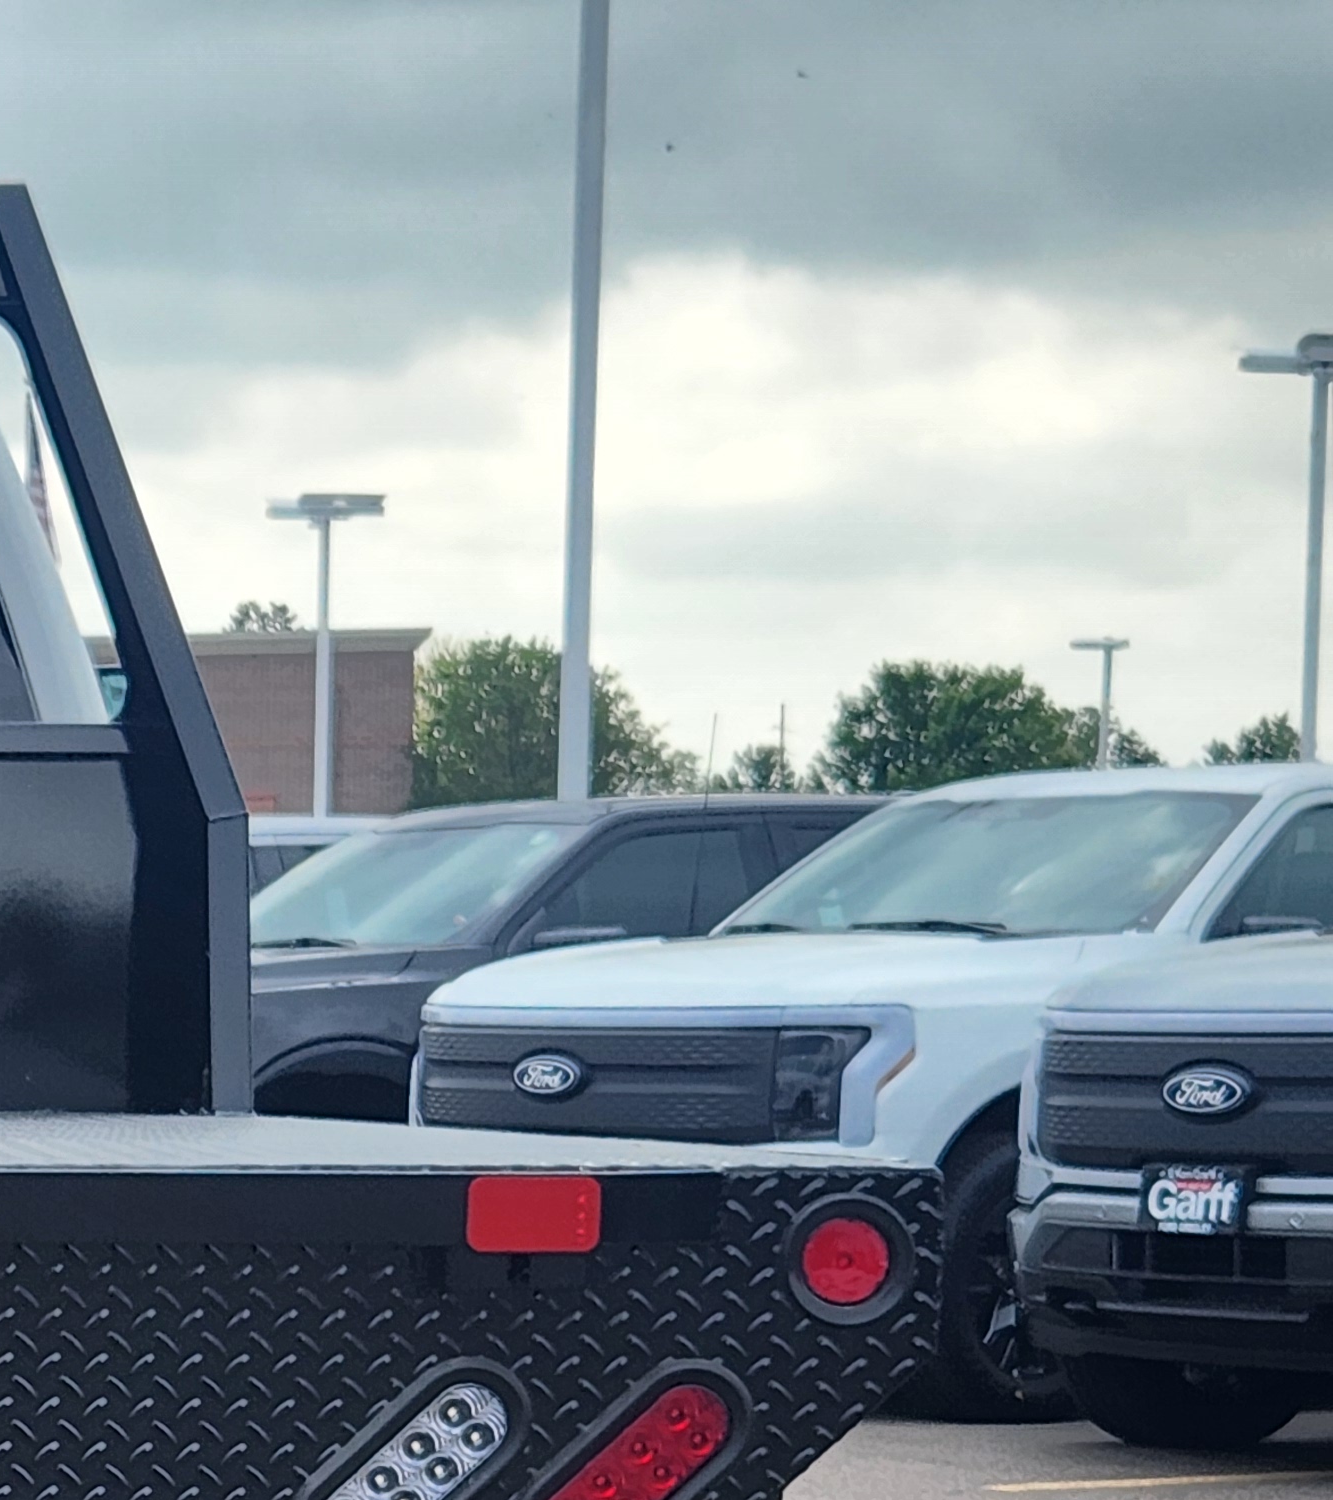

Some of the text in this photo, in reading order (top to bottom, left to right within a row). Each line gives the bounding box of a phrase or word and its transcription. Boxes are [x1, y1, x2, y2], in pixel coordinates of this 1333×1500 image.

[523, 1064, 563, 1088] Ford
[1175, 1078, 1228, 1106] Ford
[1148, 1178, 1239, 1225] Garff
